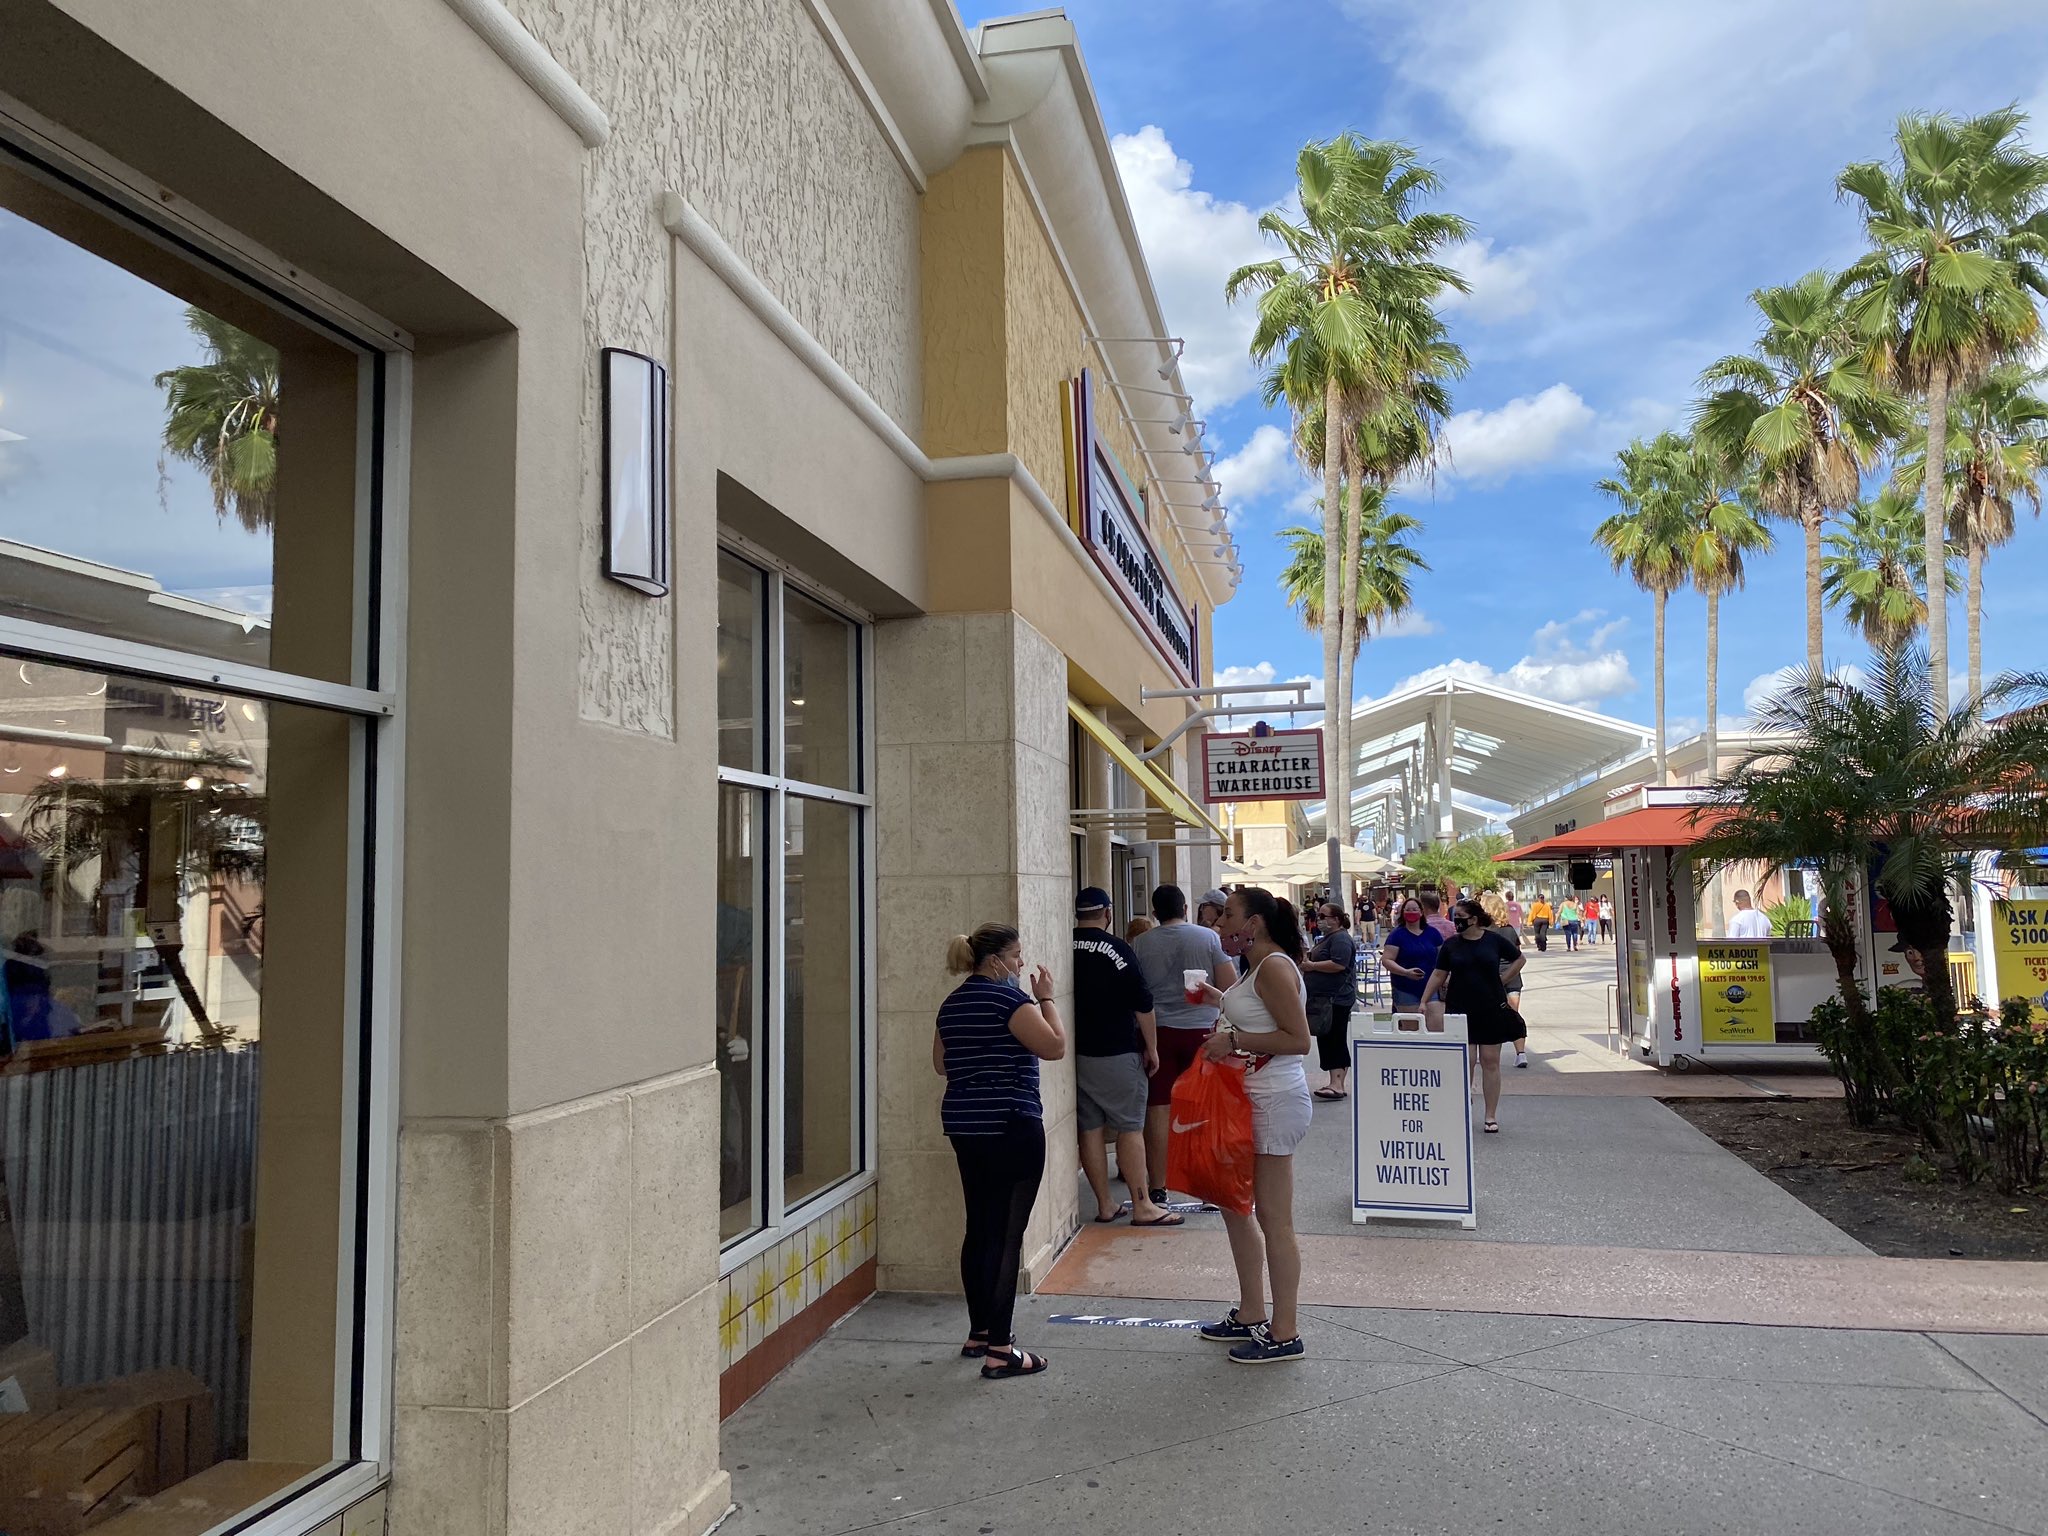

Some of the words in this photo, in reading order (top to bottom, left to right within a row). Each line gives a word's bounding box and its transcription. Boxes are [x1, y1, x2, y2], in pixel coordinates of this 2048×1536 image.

[1217, 758, 1310, 774] CHARACTER
[1217, 776, 1311, 792] WAREHOUSE
[1630, 853, 1640, 931] TICKETS
[2008, 909, 2038, 926] ASK
[2010, 927, 2048, 946] $100
[1072, 940, 1098, 953] sney
[1097, 941, 1128, 970] World
[1708, 949, 1725, 959] ASK
[1728, 949, 1759, 959] ABOUT
[1710, 960, 1731, 971] $100
[1735, 960, 1758, 970] CASH
[1669, 952, 1682, 1041] TICKETS
[1719, 1027, 1755, 1035] SeaWorld
[1381, 1068, 1441, 1087] RETURN
[1393, 1093, 1430, 1111] HERE
[1402, 1119, 1423, 1133] FOR
[1380, 1140, 1446, 1161] VIRTUAL
[1376, 1164, 1450, 1187] WAITLIST
[1089, 1320, 1143, 1328] PLEASE
